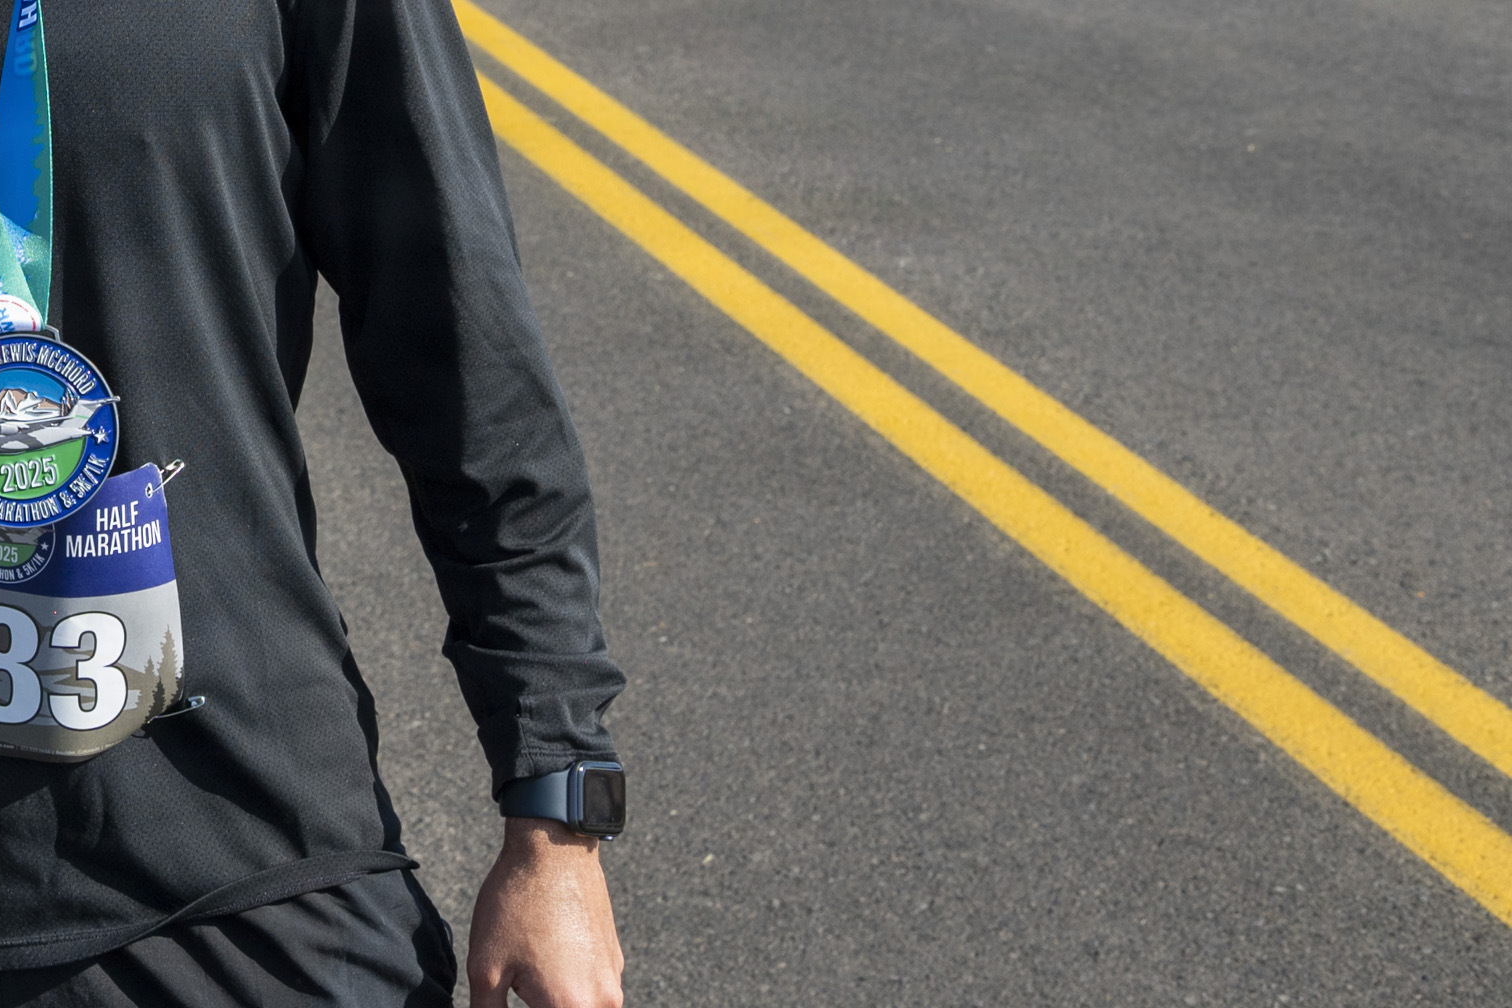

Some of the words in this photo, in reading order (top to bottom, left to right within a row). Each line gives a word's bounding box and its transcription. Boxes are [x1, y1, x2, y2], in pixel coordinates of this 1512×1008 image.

[0, 456, 58, 494] 2025
[59, 490, 77, 508] &
[70, 452, 110, 499] 5K/1K
[95, 500, 139, 533] HALF
[65, 518, 162, 558] MARATHON
[16, 567, 25, 580] &
[24, 552, 46, 576] 5K/1K
